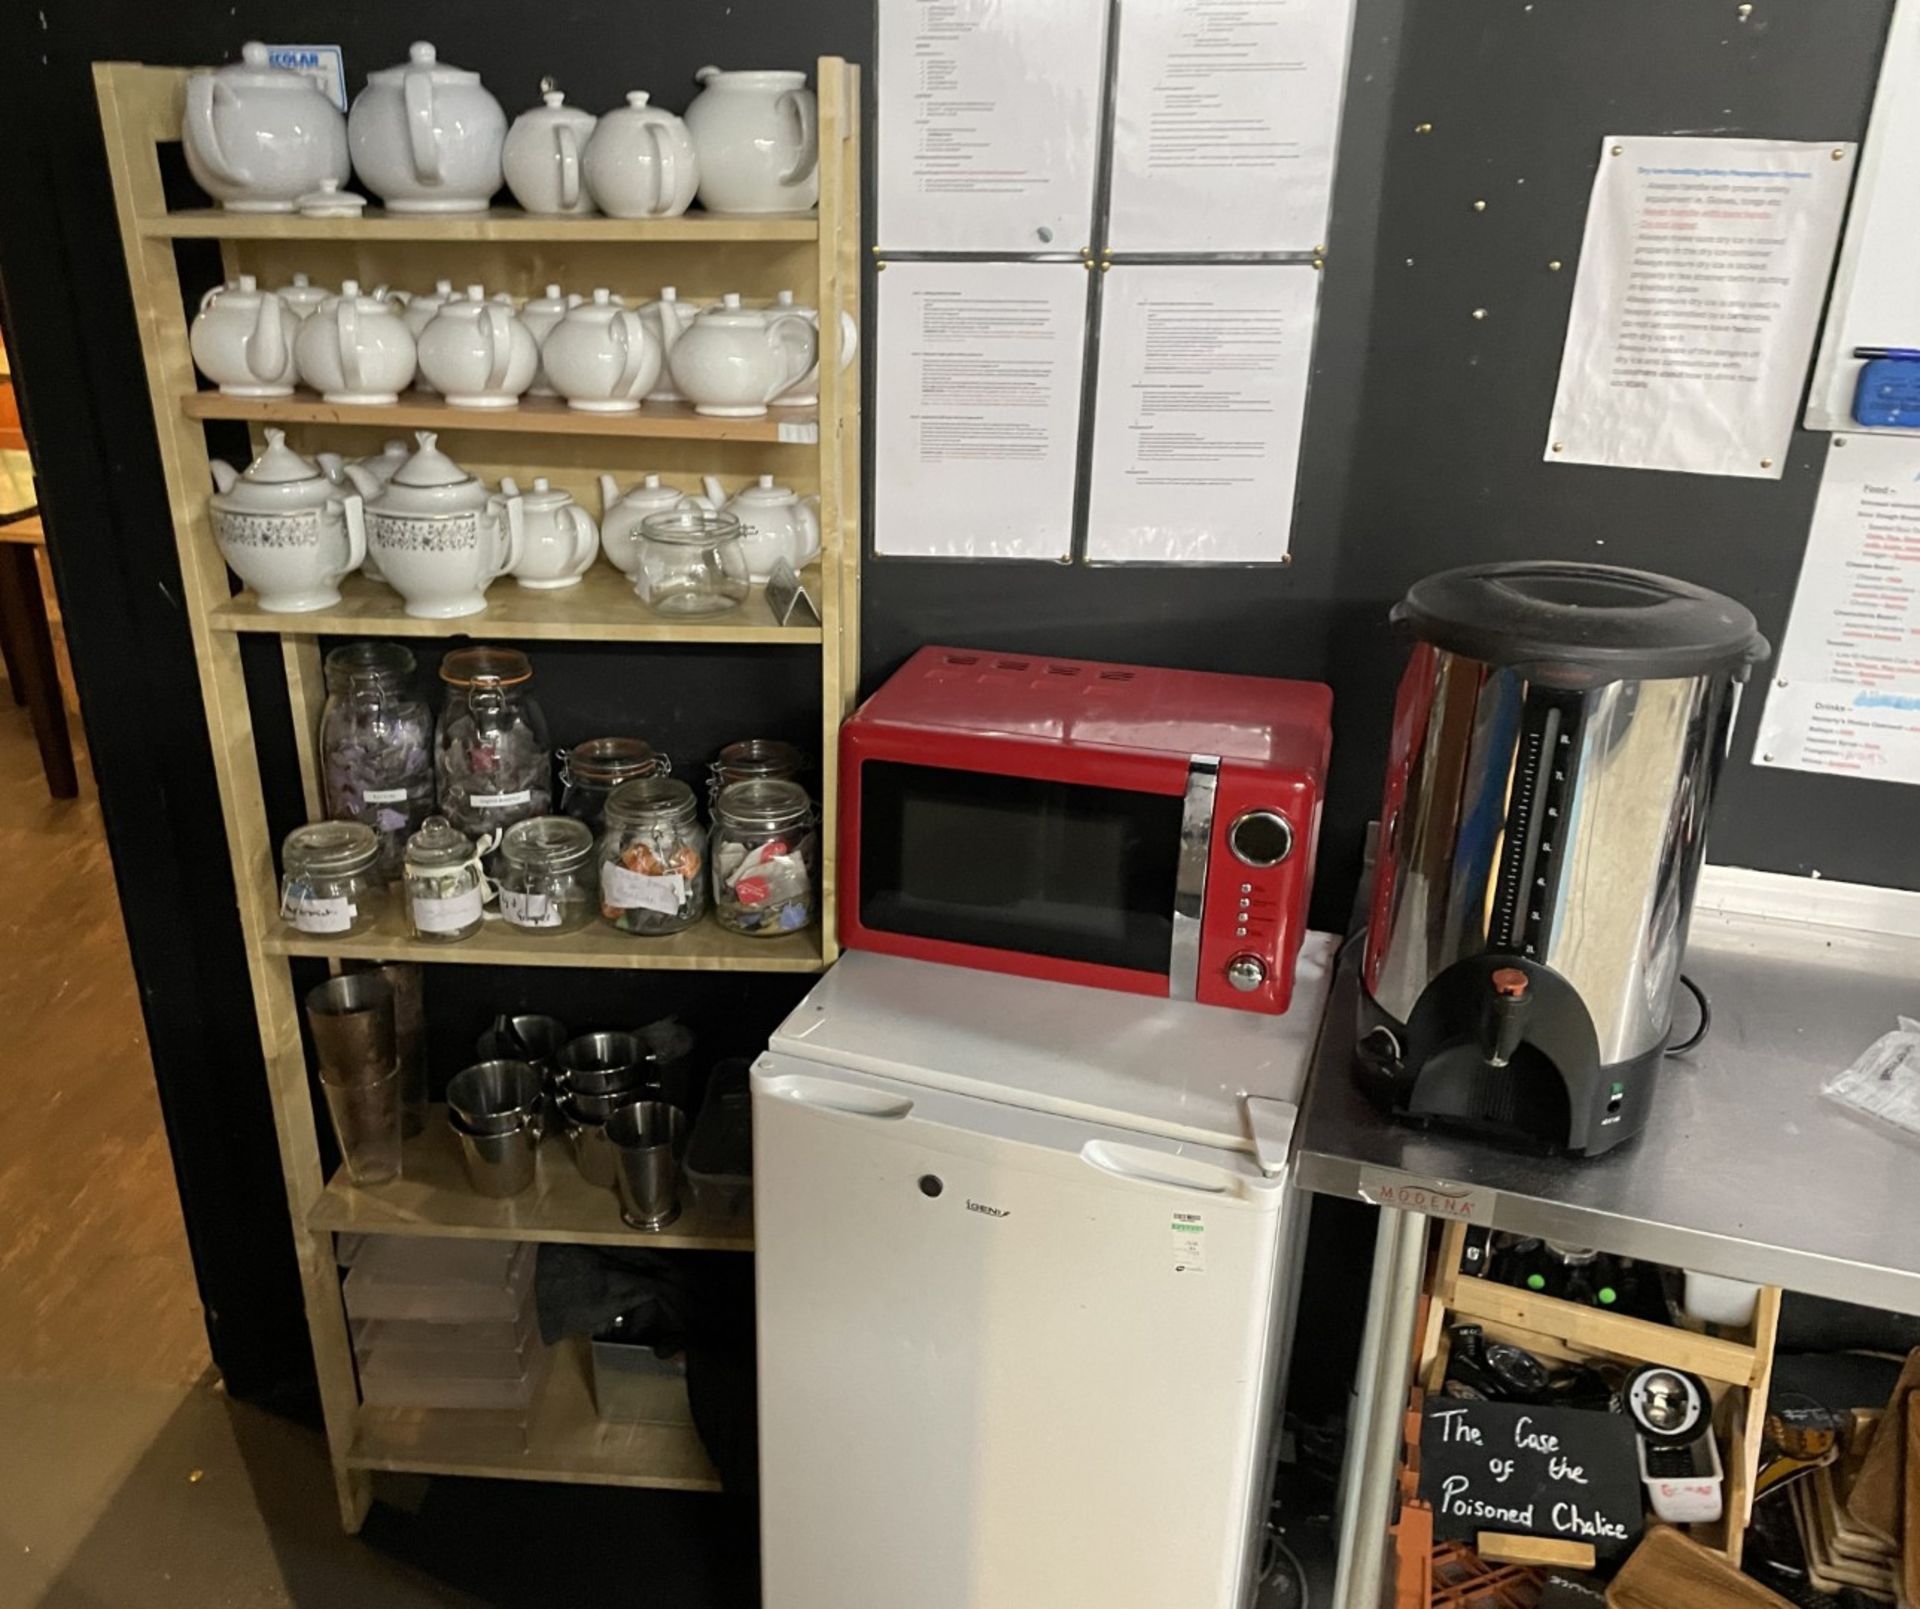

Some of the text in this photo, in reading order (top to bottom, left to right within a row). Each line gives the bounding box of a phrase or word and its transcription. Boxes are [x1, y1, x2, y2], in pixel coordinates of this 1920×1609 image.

[1380, 1186, 1472, 1214] MODENA
[1430, 1408, 1560, 1453] The Case
[1489, 1456, 1588, 1484] of the
[1441, 1475, 1629, 1540] Poisoned Chalice
